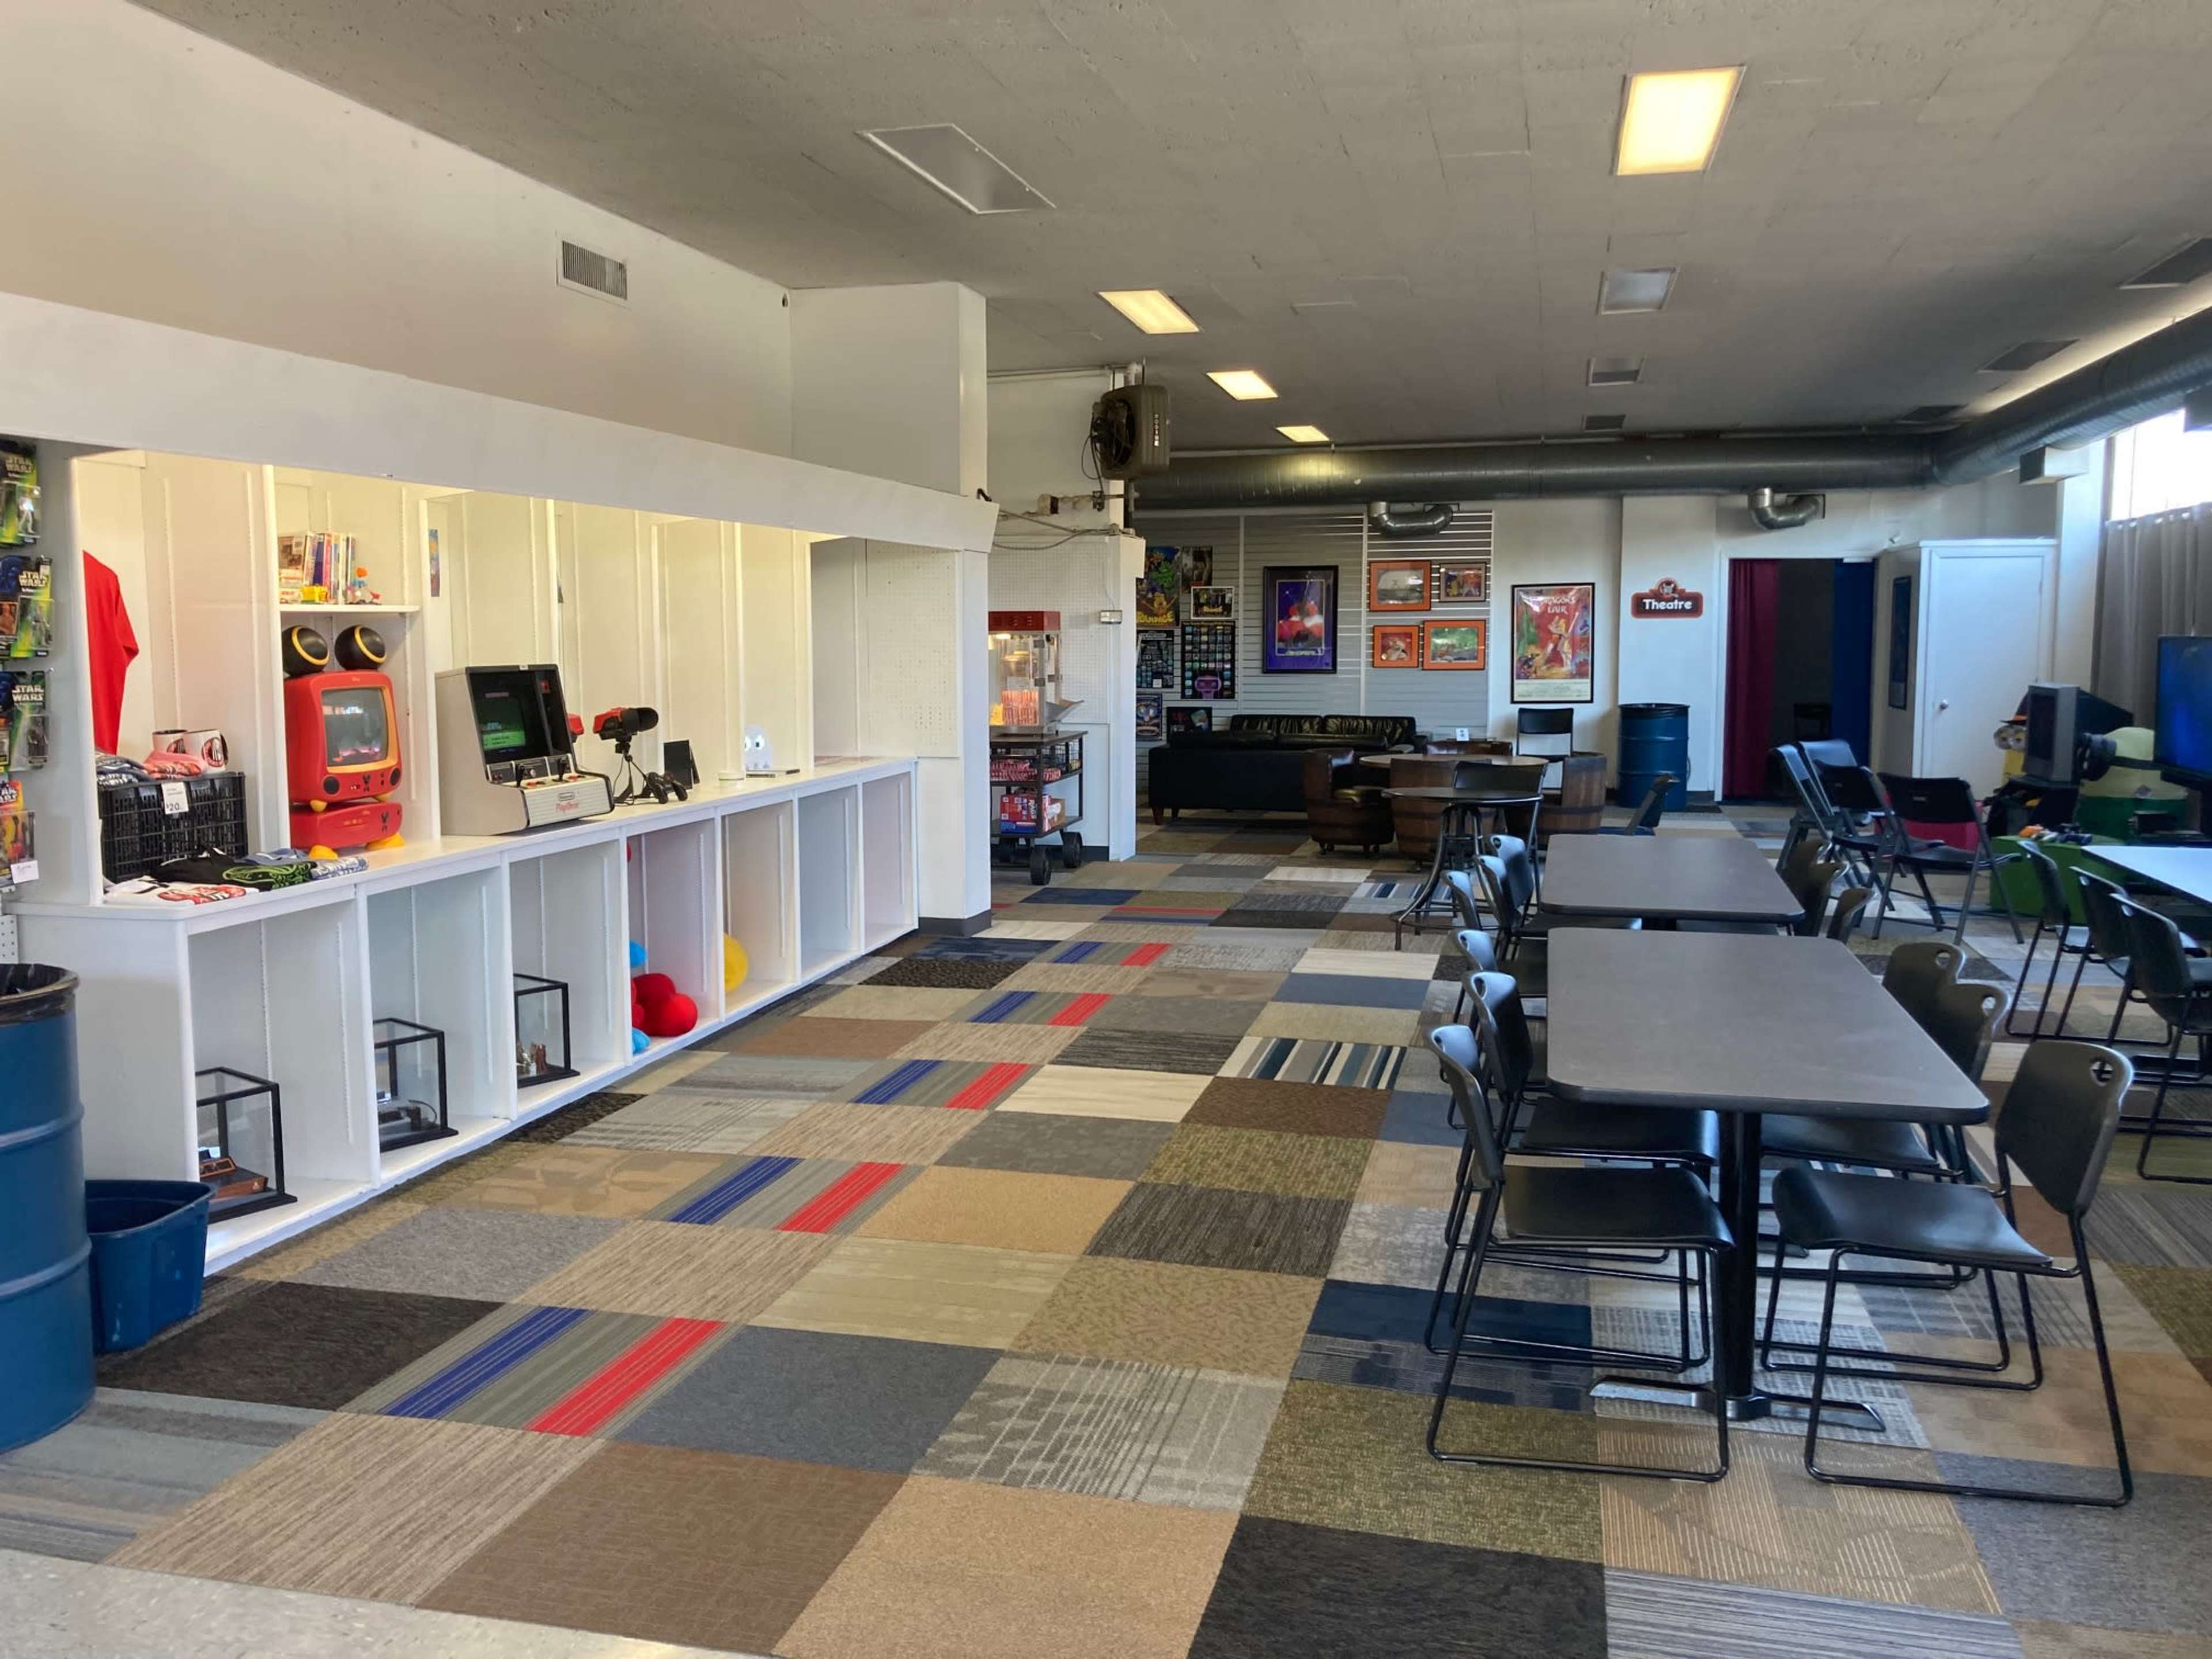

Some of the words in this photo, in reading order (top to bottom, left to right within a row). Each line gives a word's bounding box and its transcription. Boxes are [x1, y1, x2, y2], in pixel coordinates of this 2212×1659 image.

[1642, 599, 1692, 610] Theatre
[12, 684, 44, 693] STAR
[12, 693, 44, 702] WARS
[166, 802, 180, 811] $20
